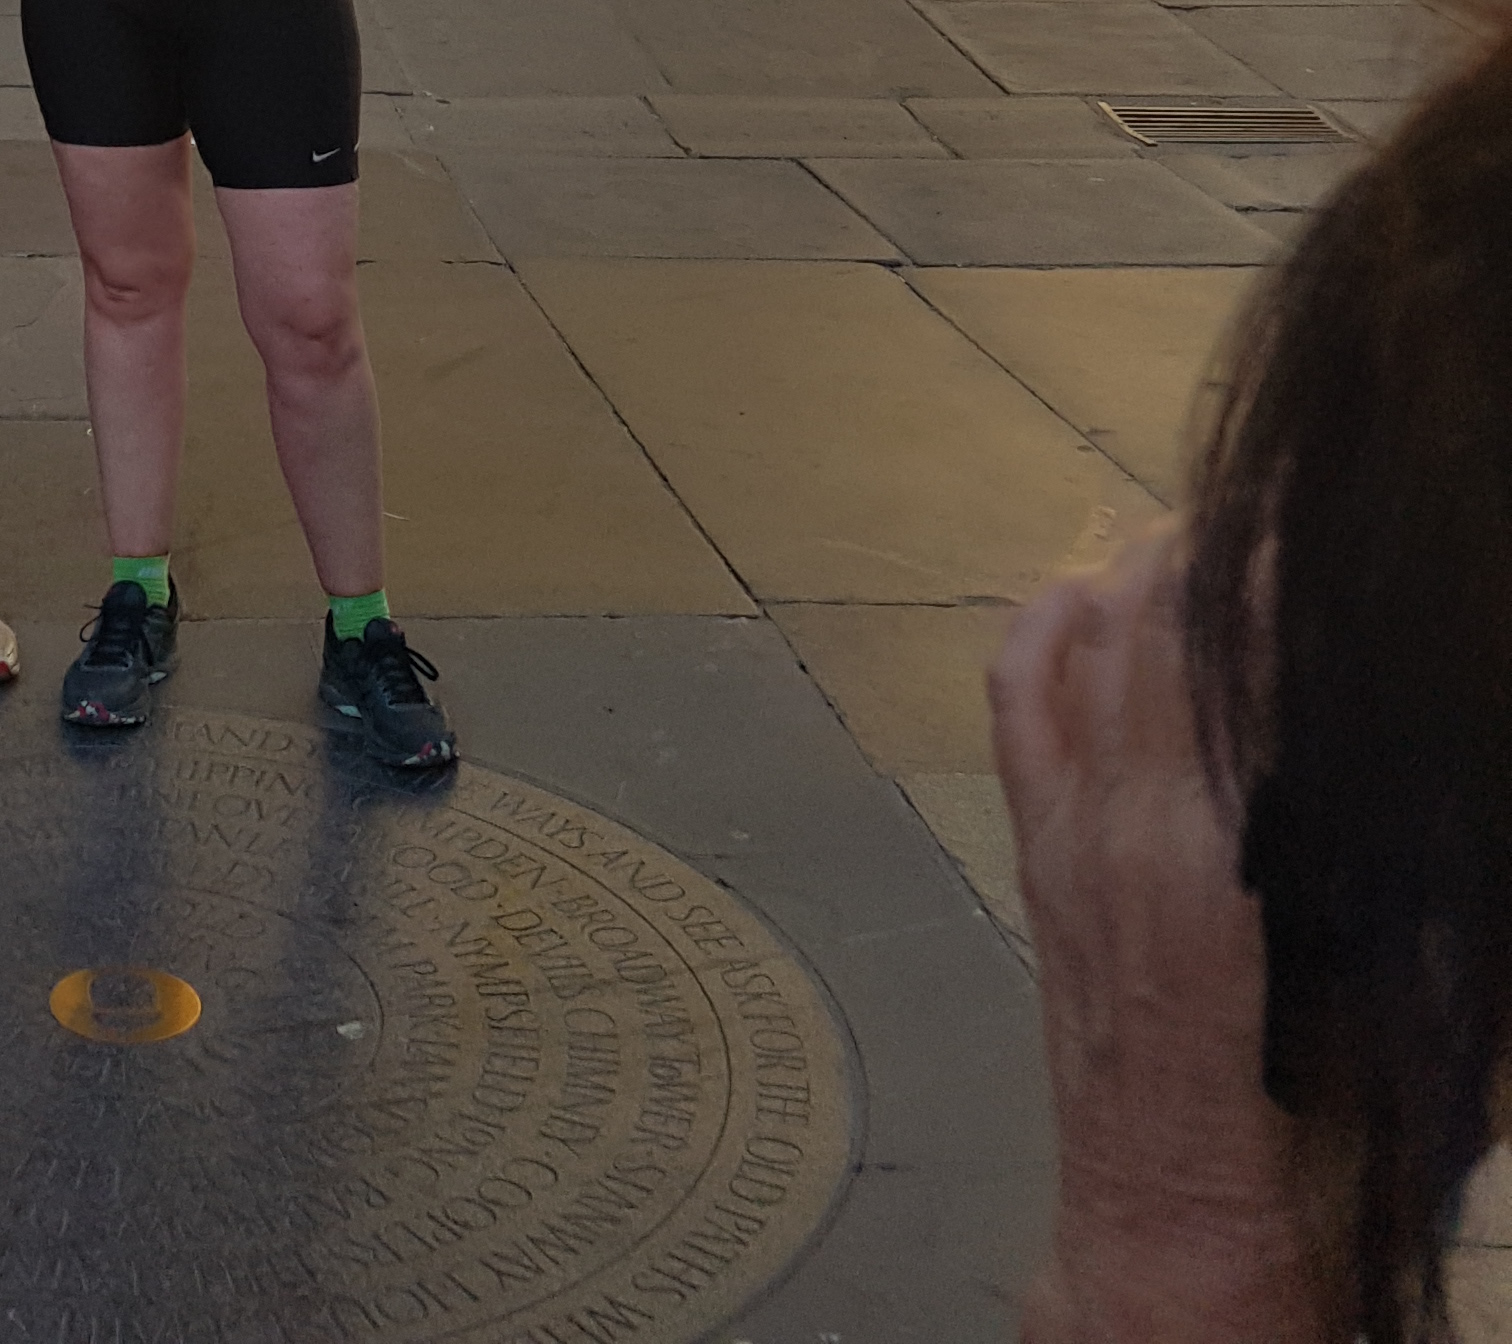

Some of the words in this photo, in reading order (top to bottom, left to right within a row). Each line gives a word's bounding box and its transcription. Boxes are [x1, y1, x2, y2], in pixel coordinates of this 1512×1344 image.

[489, 789, 592, 851] WAYS
[589, 848, 686, 904] AND
[664, 903, 745, 957] SEE
[549, 892, 696, 1048] BROADWAY
[721, 958, 781, 1009] ASK
[445, 920, 541, 1113] NYMPSFIELD
[741, 1011, 809, 1072] FOR
[538, 1007, 621, 1158] CHIMNEY
[755, 1078, 811, 1126] THE
[728, 1135, 804, 1207] OLD
[479, 1150, 667, 1291] STANWAY
[631, 1200, 768, 1303] PATHS
